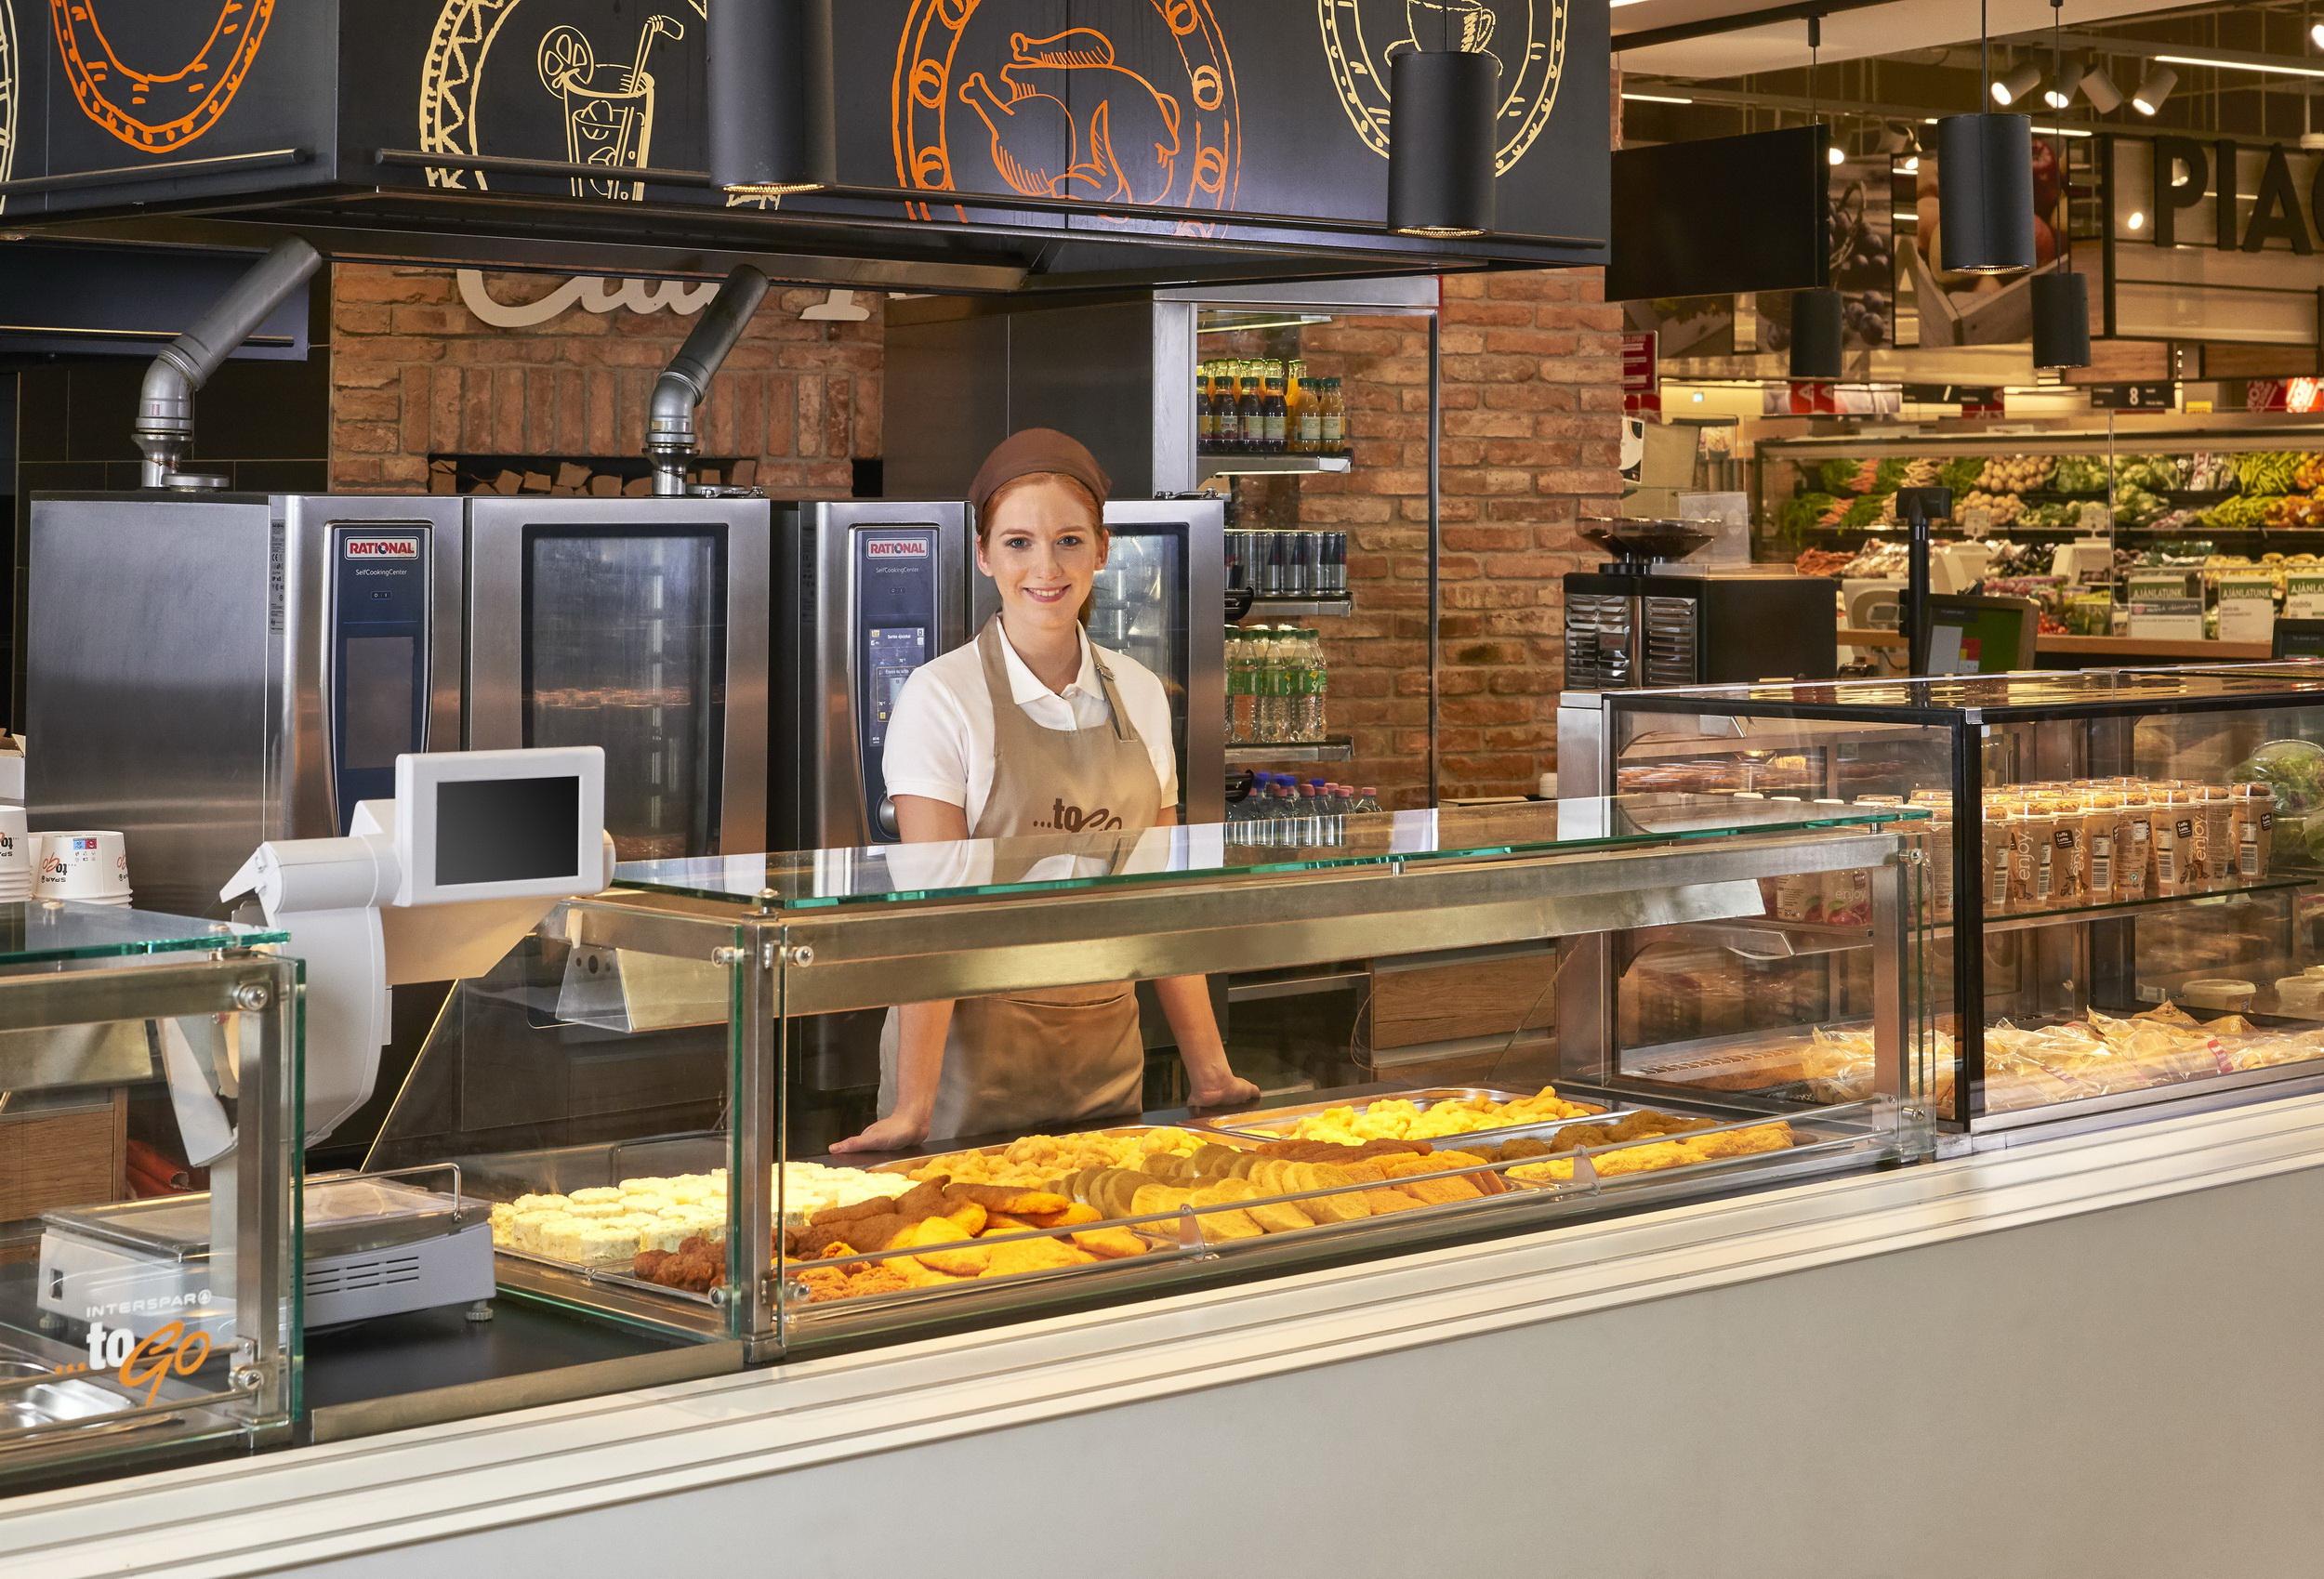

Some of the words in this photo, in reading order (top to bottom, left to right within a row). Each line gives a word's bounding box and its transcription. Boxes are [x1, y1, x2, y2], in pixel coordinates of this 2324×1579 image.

[2154, 136, 2324, 256] PIA
[2129, 387, 2139, 405] 8
[349, 542, 415, 555] RATIONAL
[870, 543, 925, 554] RATIONAL
[355, 569, 407, 577] SelfCookingCenter
[2132, 586, 2183, 599] AJÁNLATUNK
[2223, 586, 2271, 600] AJÁNLATUNK
[2291, 582, 2324, 594] AJÁNLA
[86, 1292, 198, 1319] INTERSPAR
[118, 1320, 212, 1408] Go
